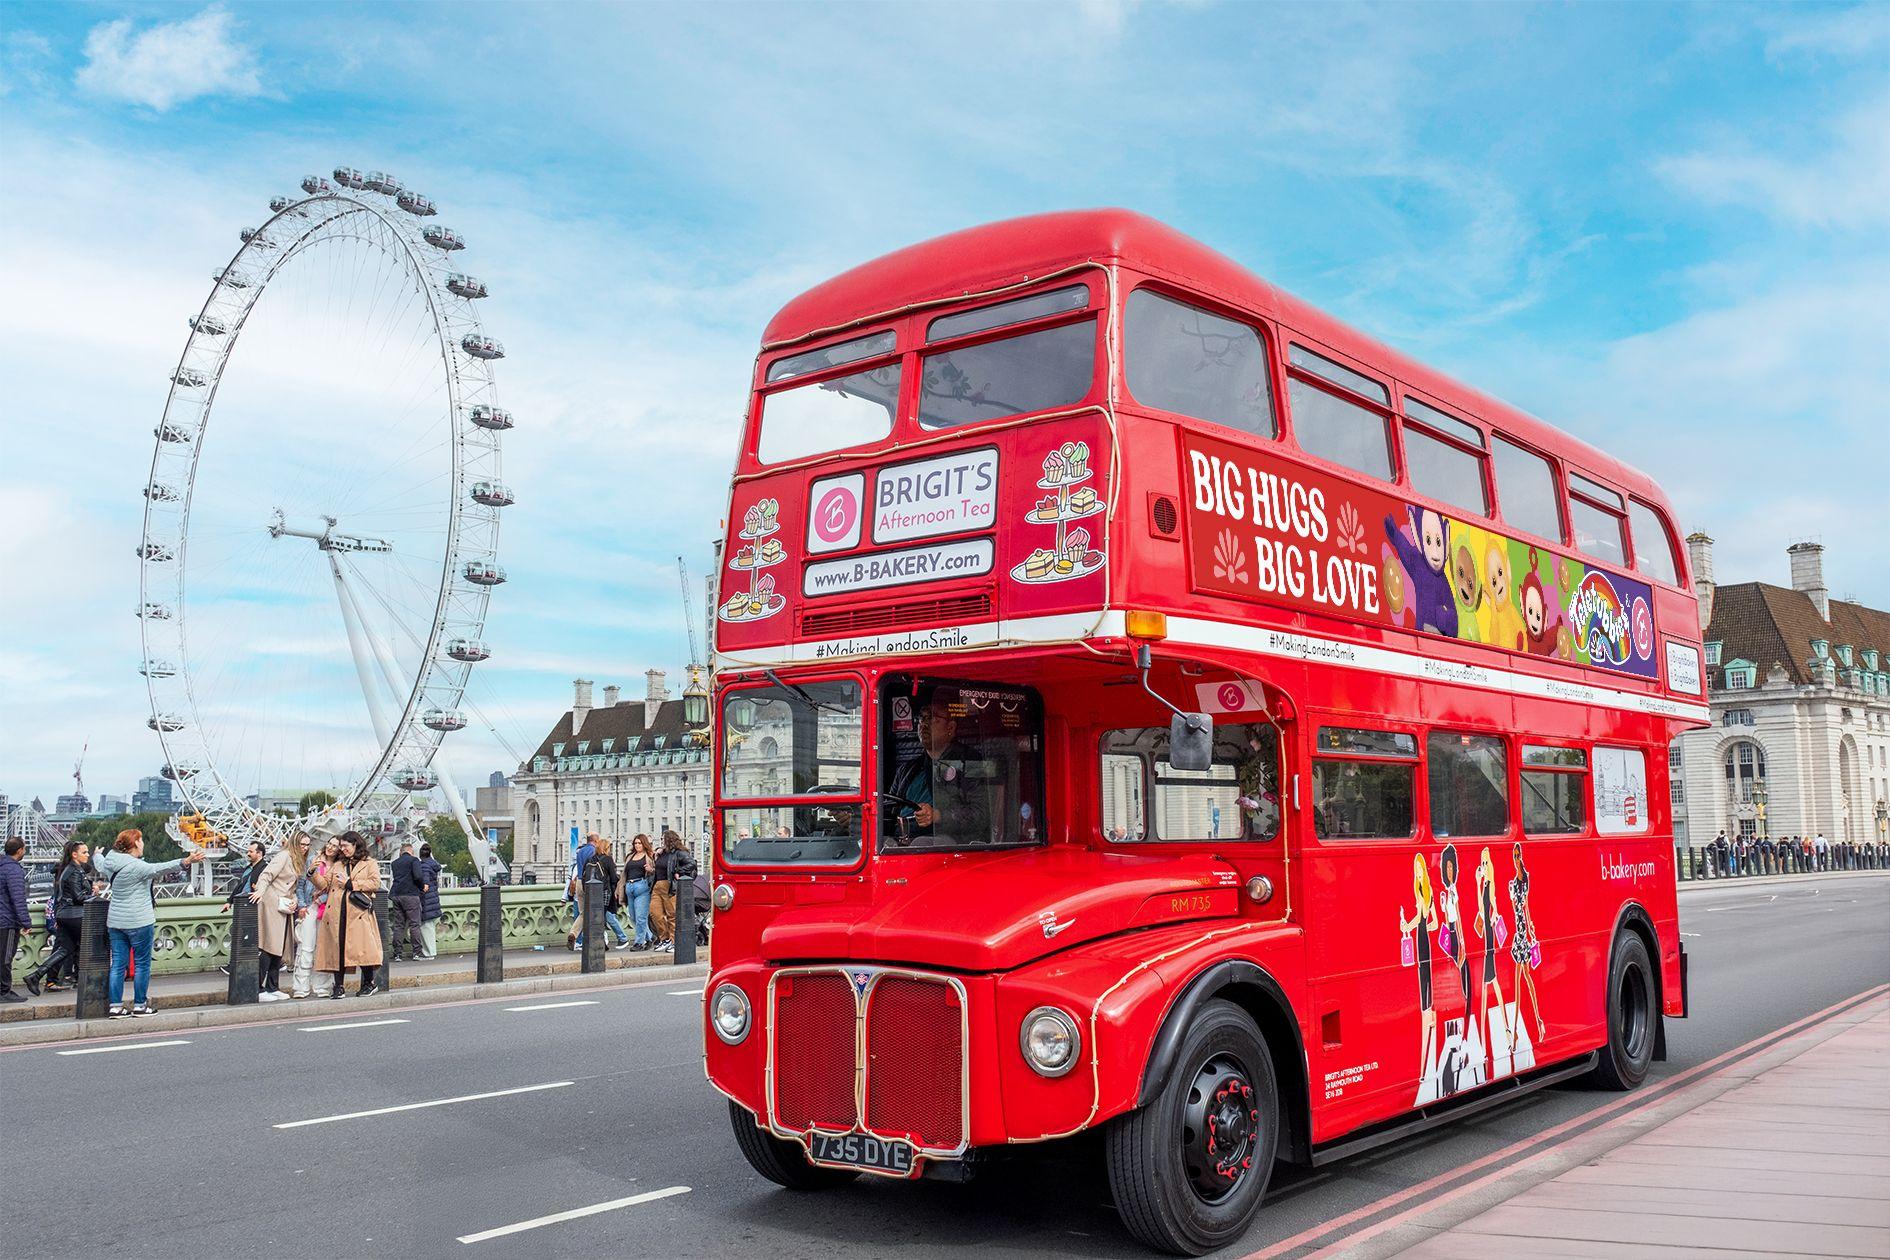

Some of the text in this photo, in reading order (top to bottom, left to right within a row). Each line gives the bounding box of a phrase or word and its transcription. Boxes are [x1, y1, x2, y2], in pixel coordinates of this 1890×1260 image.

[879, 462, 992, 508] BRIGIT'S
[1189, 449, 1329, 543] BIG HUGS
[878, 499, 991, 531] Afternoon Tea
[815, 552, 980, 588] www.B-BAKERY.com
[1254, 536, 1380, 614] BIG LOVE
[1569, 582, 1629, 643] Teletubbies
[1269, 633, 1355, 661] #MakingLondonSmile
[959, 689, 987, 699] EMERGENCY
[1600, 853, 1655, 885] b-bakery.com
[1171, 895, 1211, 913] RM 735
[815, 1134, 909, 1170] 735 DYE
